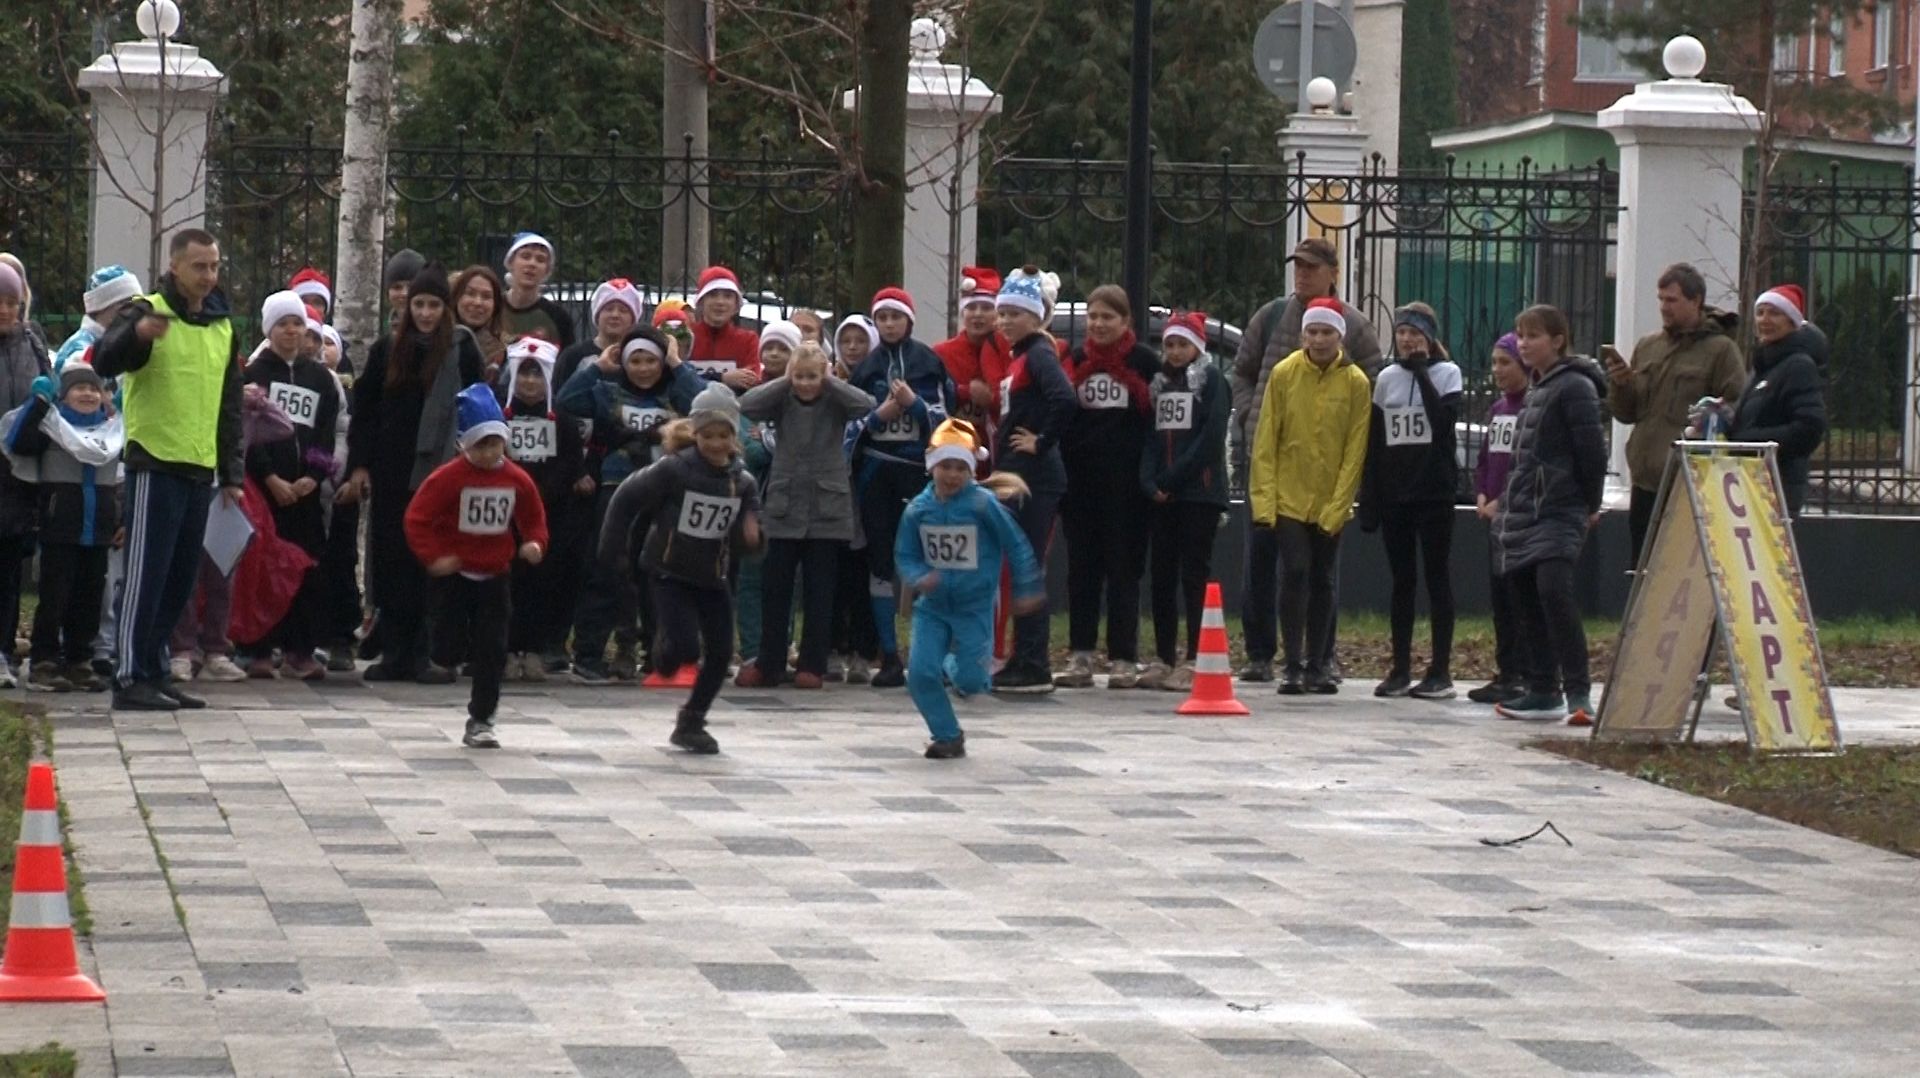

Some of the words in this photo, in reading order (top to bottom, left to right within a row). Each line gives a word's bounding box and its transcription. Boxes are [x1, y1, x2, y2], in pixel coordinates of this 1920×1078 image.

[277, 389, 313, 418] 556
[1084, 379, 1121, 403] 596
[511, 426, 549, 450] 554
[1391, 413, 1425, 439] 515
[1489, 422, 1513, 445] 516
[468, 495, 510, 525] 553
[688, 501, 733, 531] 573
[926, 533, 969, 561] 552
[1723, 472, 1792, 735] СТАРТ
